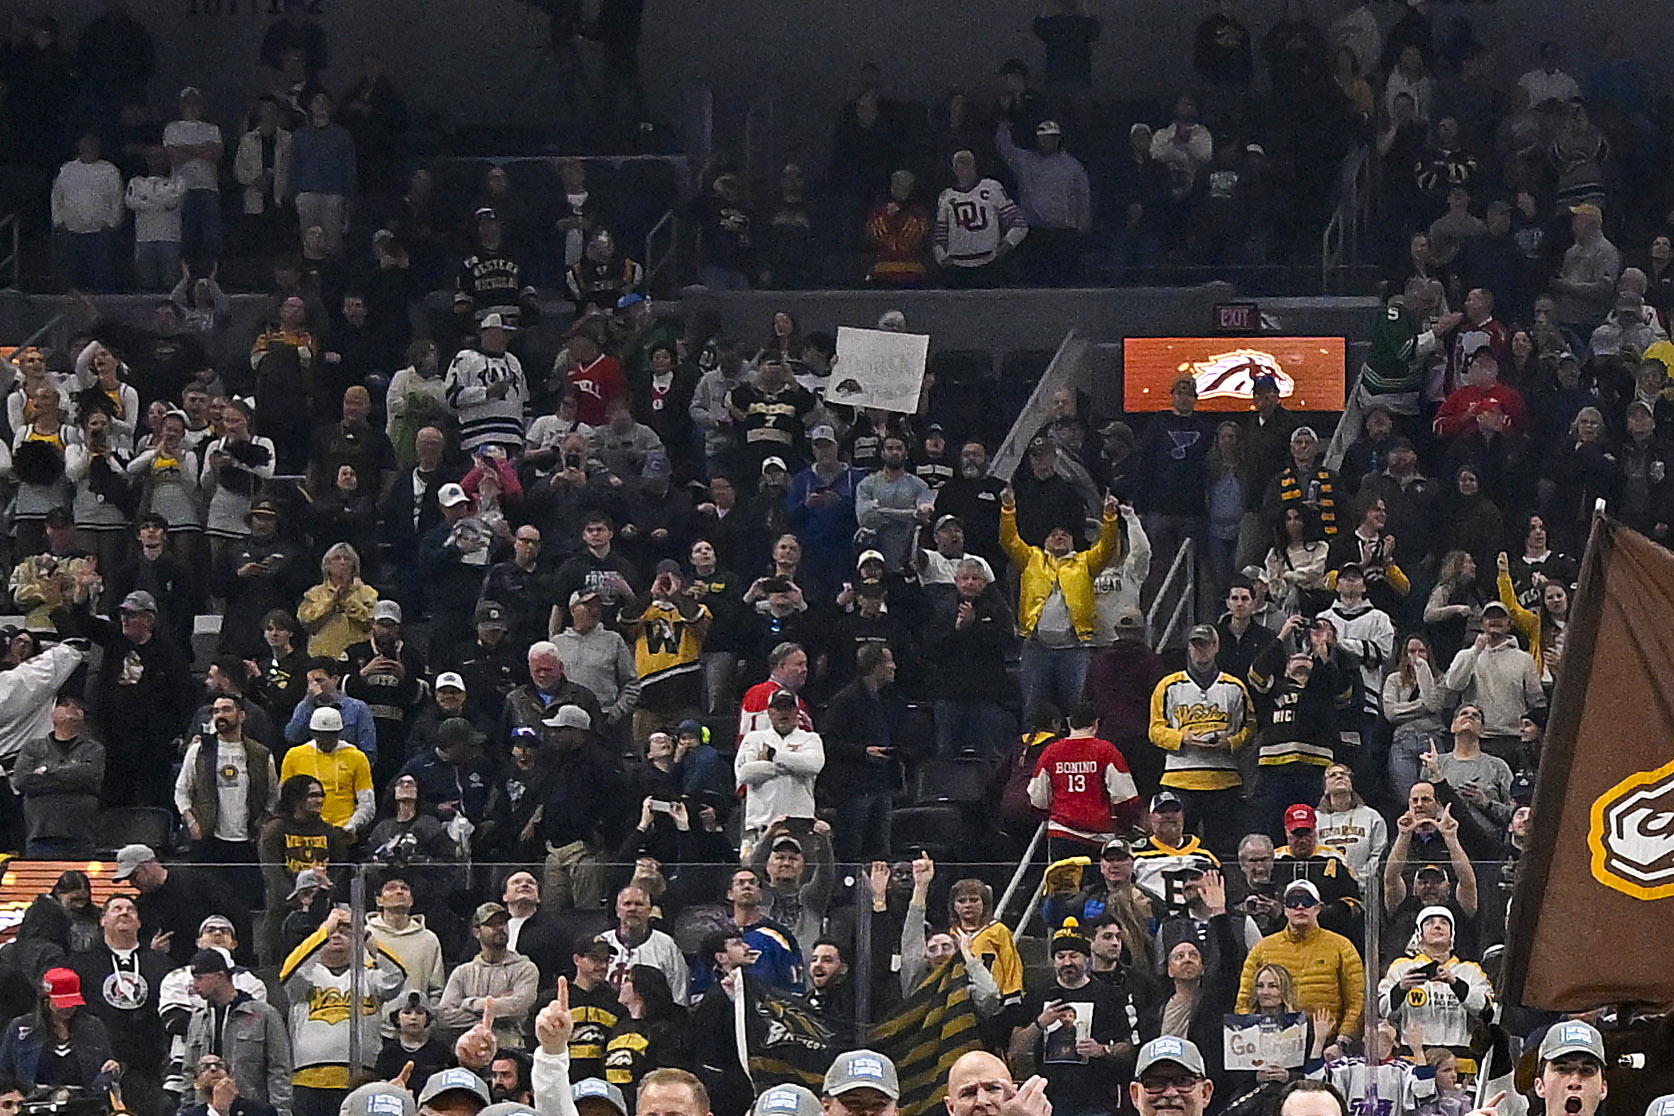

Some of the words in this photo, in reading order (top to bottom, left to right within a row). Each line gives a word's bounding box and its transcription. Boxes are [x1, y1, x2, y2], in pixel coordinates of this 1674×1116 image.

[1055, 761, 1098, 775] BONINO
[1067, 775, 1087, 793] 13
[1411, 988, 1425, 1005] W
